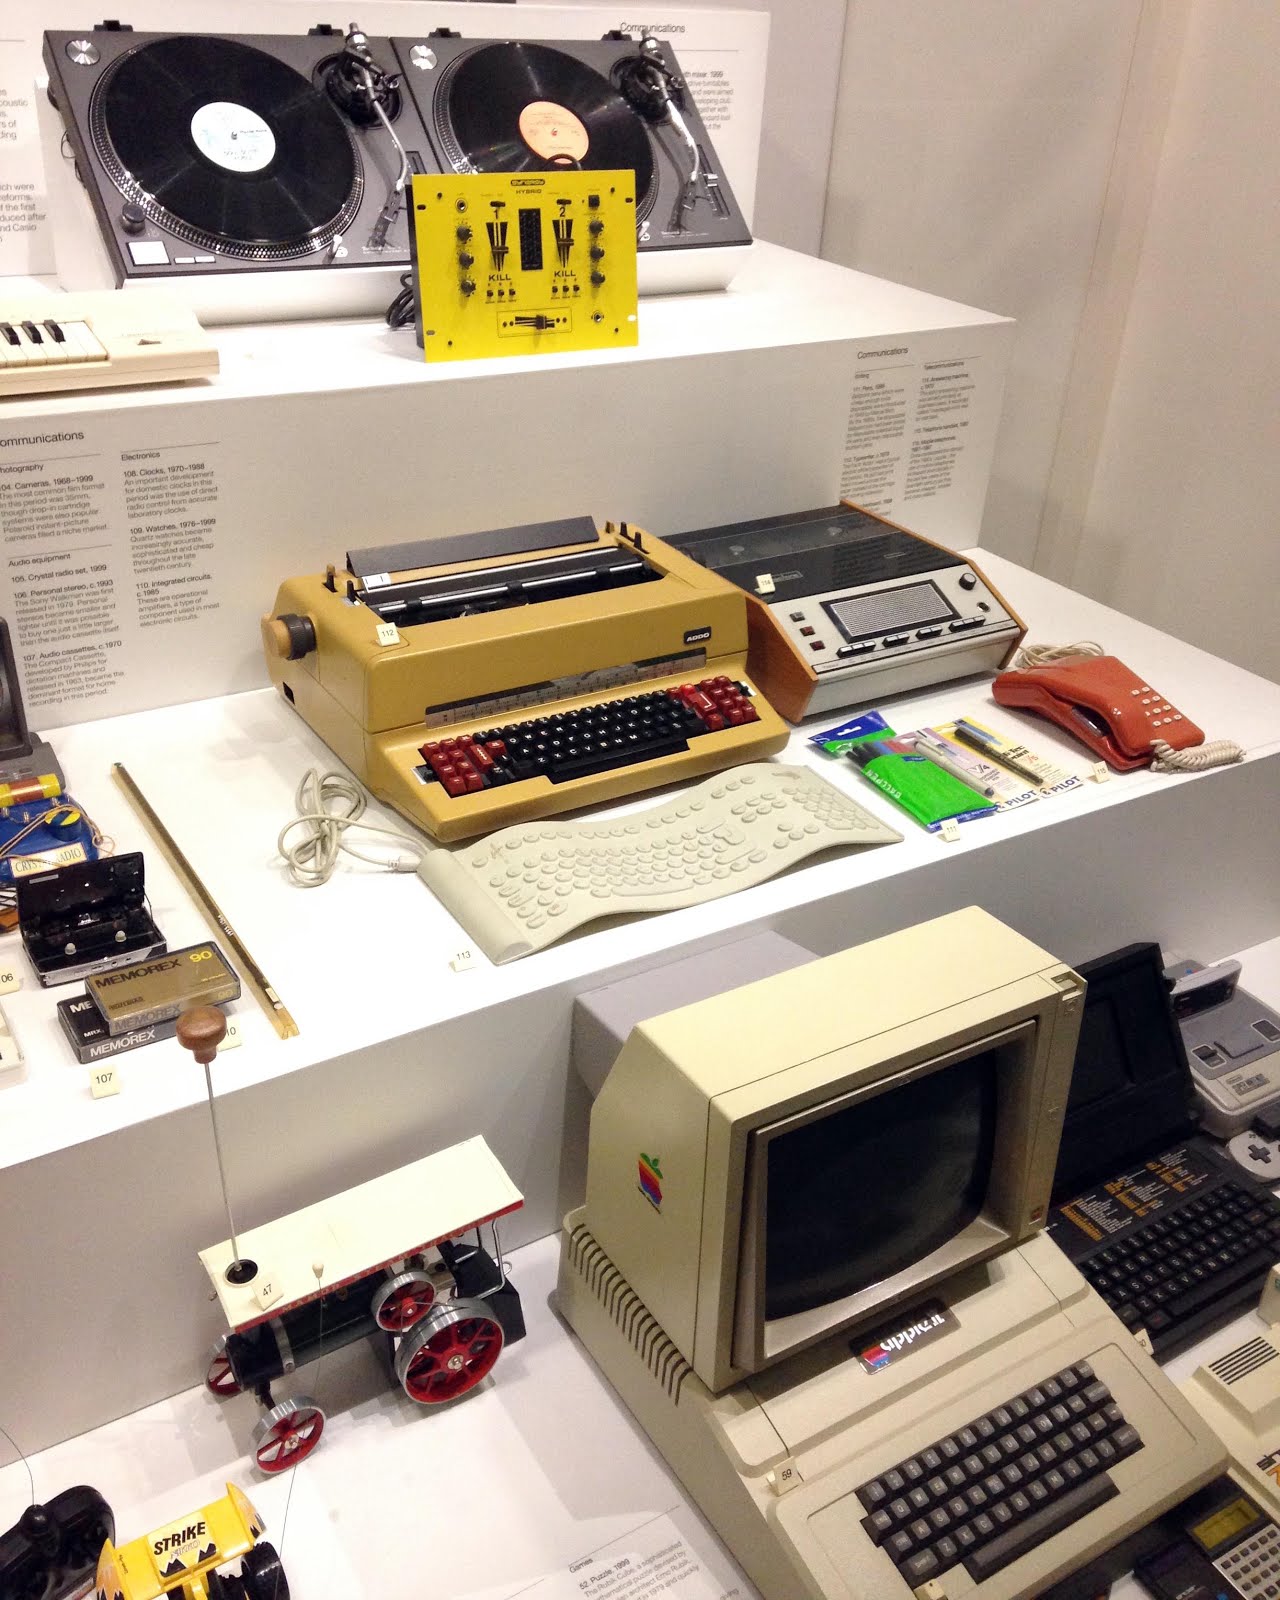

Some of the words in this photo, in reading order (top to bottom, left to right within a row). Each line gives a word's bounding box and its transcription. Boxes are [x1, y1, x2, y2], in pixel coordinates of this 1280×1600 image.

[620, 22, 686, 33] Communications
[560, 207, 566, 218] 2
[488, 274, 512, 282] KILL
[554, 270, 576, 278] KILL
[857, 348, 909, 360] Communications
[0, 432, 84, 447] ommunications
[121, 452, 160, 461] Electronics
[0, 464, 44, 473] hotography
[8, 558, 30, 567] Audio
[32, 553, 70, 564] equipment
[28, 572, 54, 582] Crystal
[55, 568, 73, 577] radio
[686, 632, 710, 642] ADDO
[40, 650, 60, 659] Audio
[1050, 776, 1081, 793] PILOT
[1004, 790, 1038, 806] PILOT
[190, 950, 212, 963] 90
[456, 950, 471, 960] 113
[0, 973, 14, 983] 06
[95, 958, 182, 988] MEMOREX
[115, 1003, 181, 1030] MEMOREX
[226, 1026, 236, 1036] 10
[90, 1029, 156, 1058] MEMOREX
[96, 1072, 113, 1084] 107
[263, 1284, 272, 1296] 47
[782, 1468, 792, 1480] 59
[154, 1522, 206, 1556] STRIKE
[170, 1540, 200, 1559] NIKKO
[569, 1558, 593, 1574] Games
[614, 1558, 630, 1572] 1999
